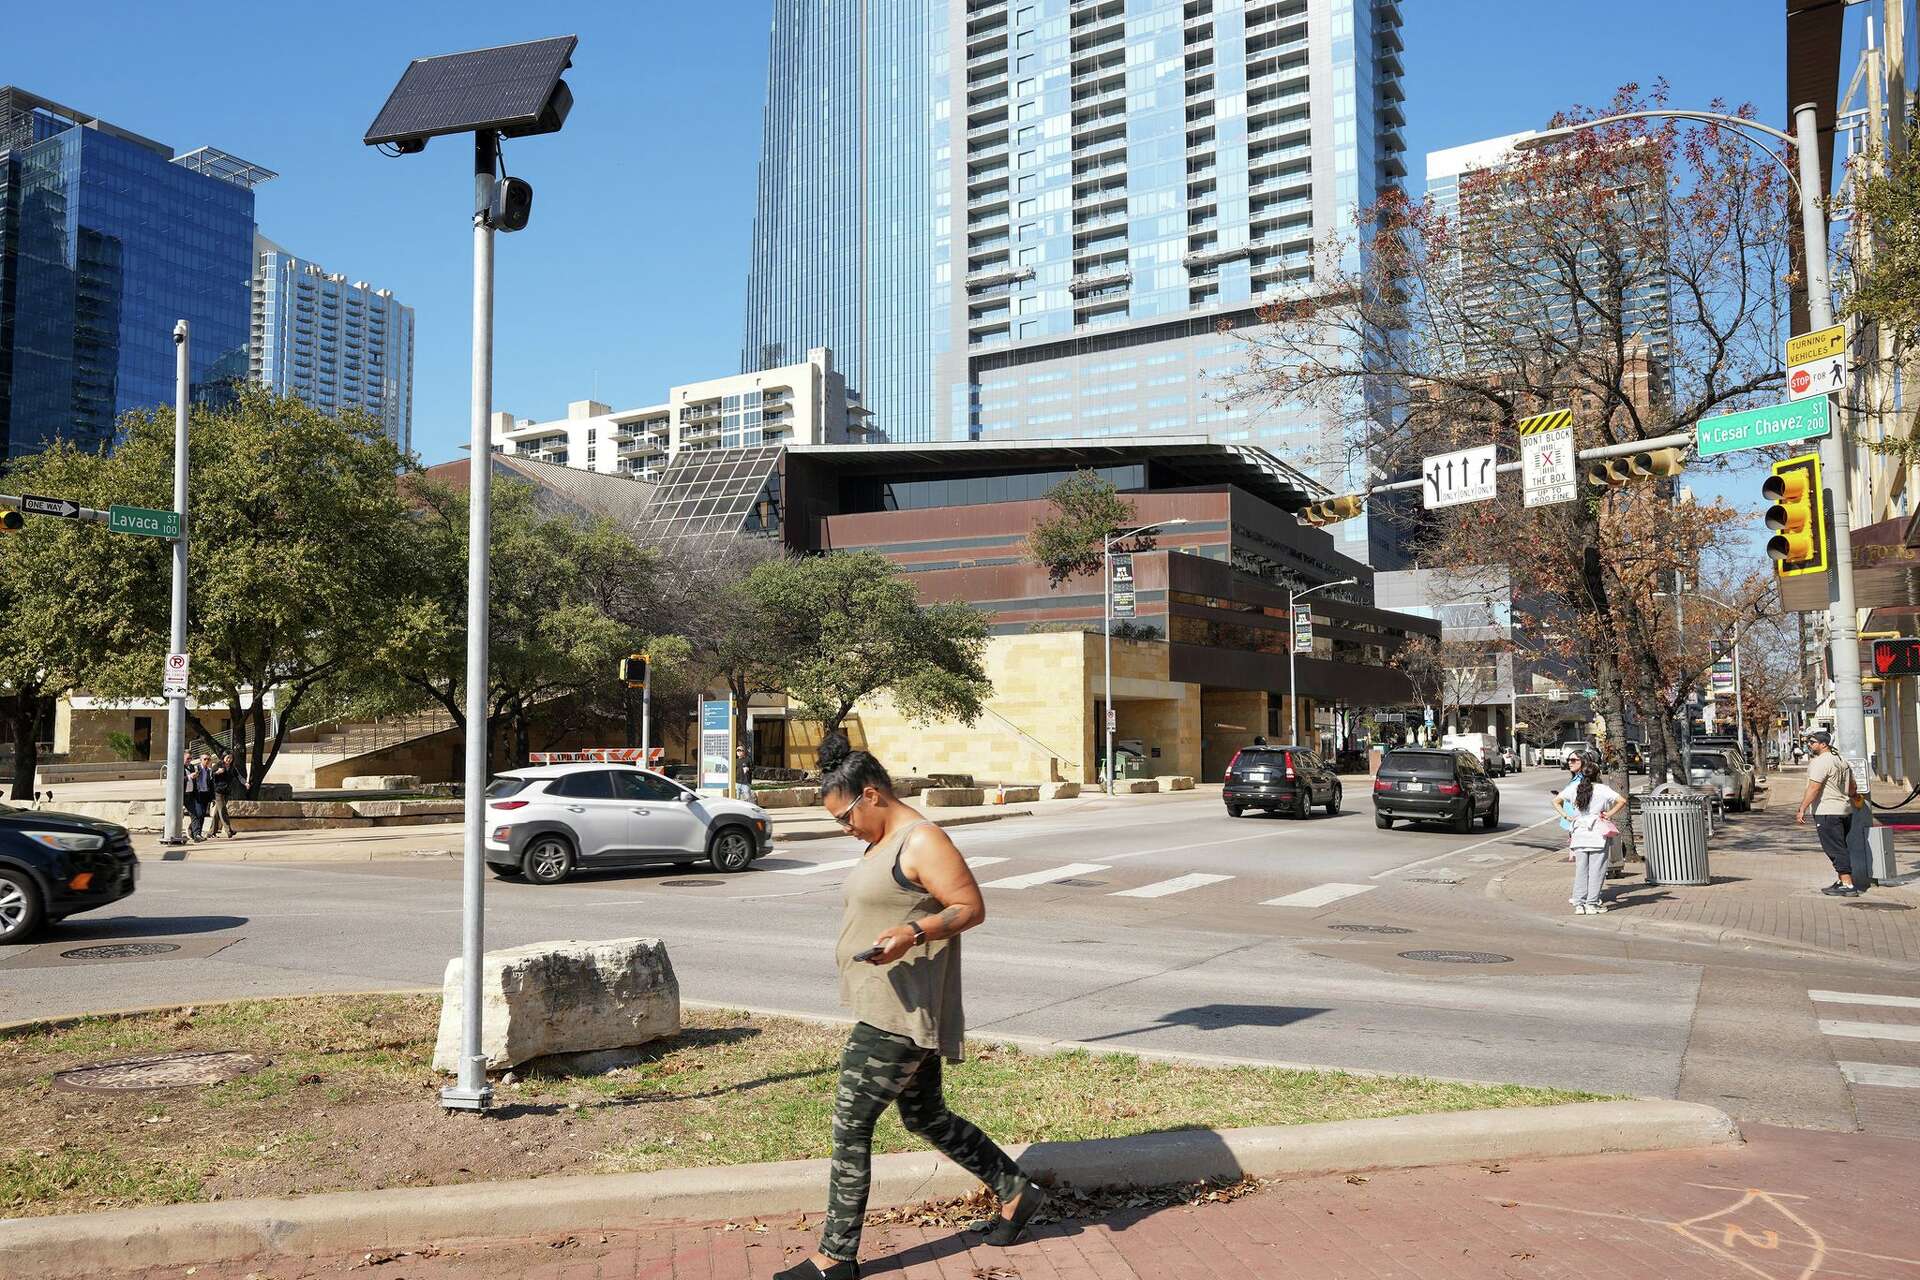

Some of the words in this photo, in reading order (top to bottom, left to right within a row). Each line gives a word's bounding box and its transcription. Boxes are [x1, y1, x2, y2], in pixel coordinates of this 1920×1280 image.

[1792, 334, 1826, 350] TURNING
[1790, 346, 1828, 363] VEHICLES
[1791, 374, 1810, 388] STOP
[1813, 371, 1826, 382] FOR
[1812, 402, 1823, 414] ST
[1546, 430, 1570, 443] BLOCK
[1702, 431, 1712, 443] W
[1714, 425, 1750, 443] Cesar
[1755, 416, 1803, 436] Chavez
[1807, 417, 1824, 431] 200
[1532, 476, 1549, 486] THE
[1550, 472, 1567, 484] BOX
[1443, 492, 1457, 501] ONLY
[1460, 488, 1475, 498] ONLY
[1478, 485, 1493, 495] ONLY
[1537, 489, 1548, 497] UP
[1552, 486, 1562, 494] TO
[1552, 492, 1569, 501] FINE
[27, 499, 44, 509] ONE
[46, 503, 63, 512] WAY
[112, 512, 159, 530] Lavaca
[167, 515, 177, 523] ST
[163, 524, 177, 534] 100
